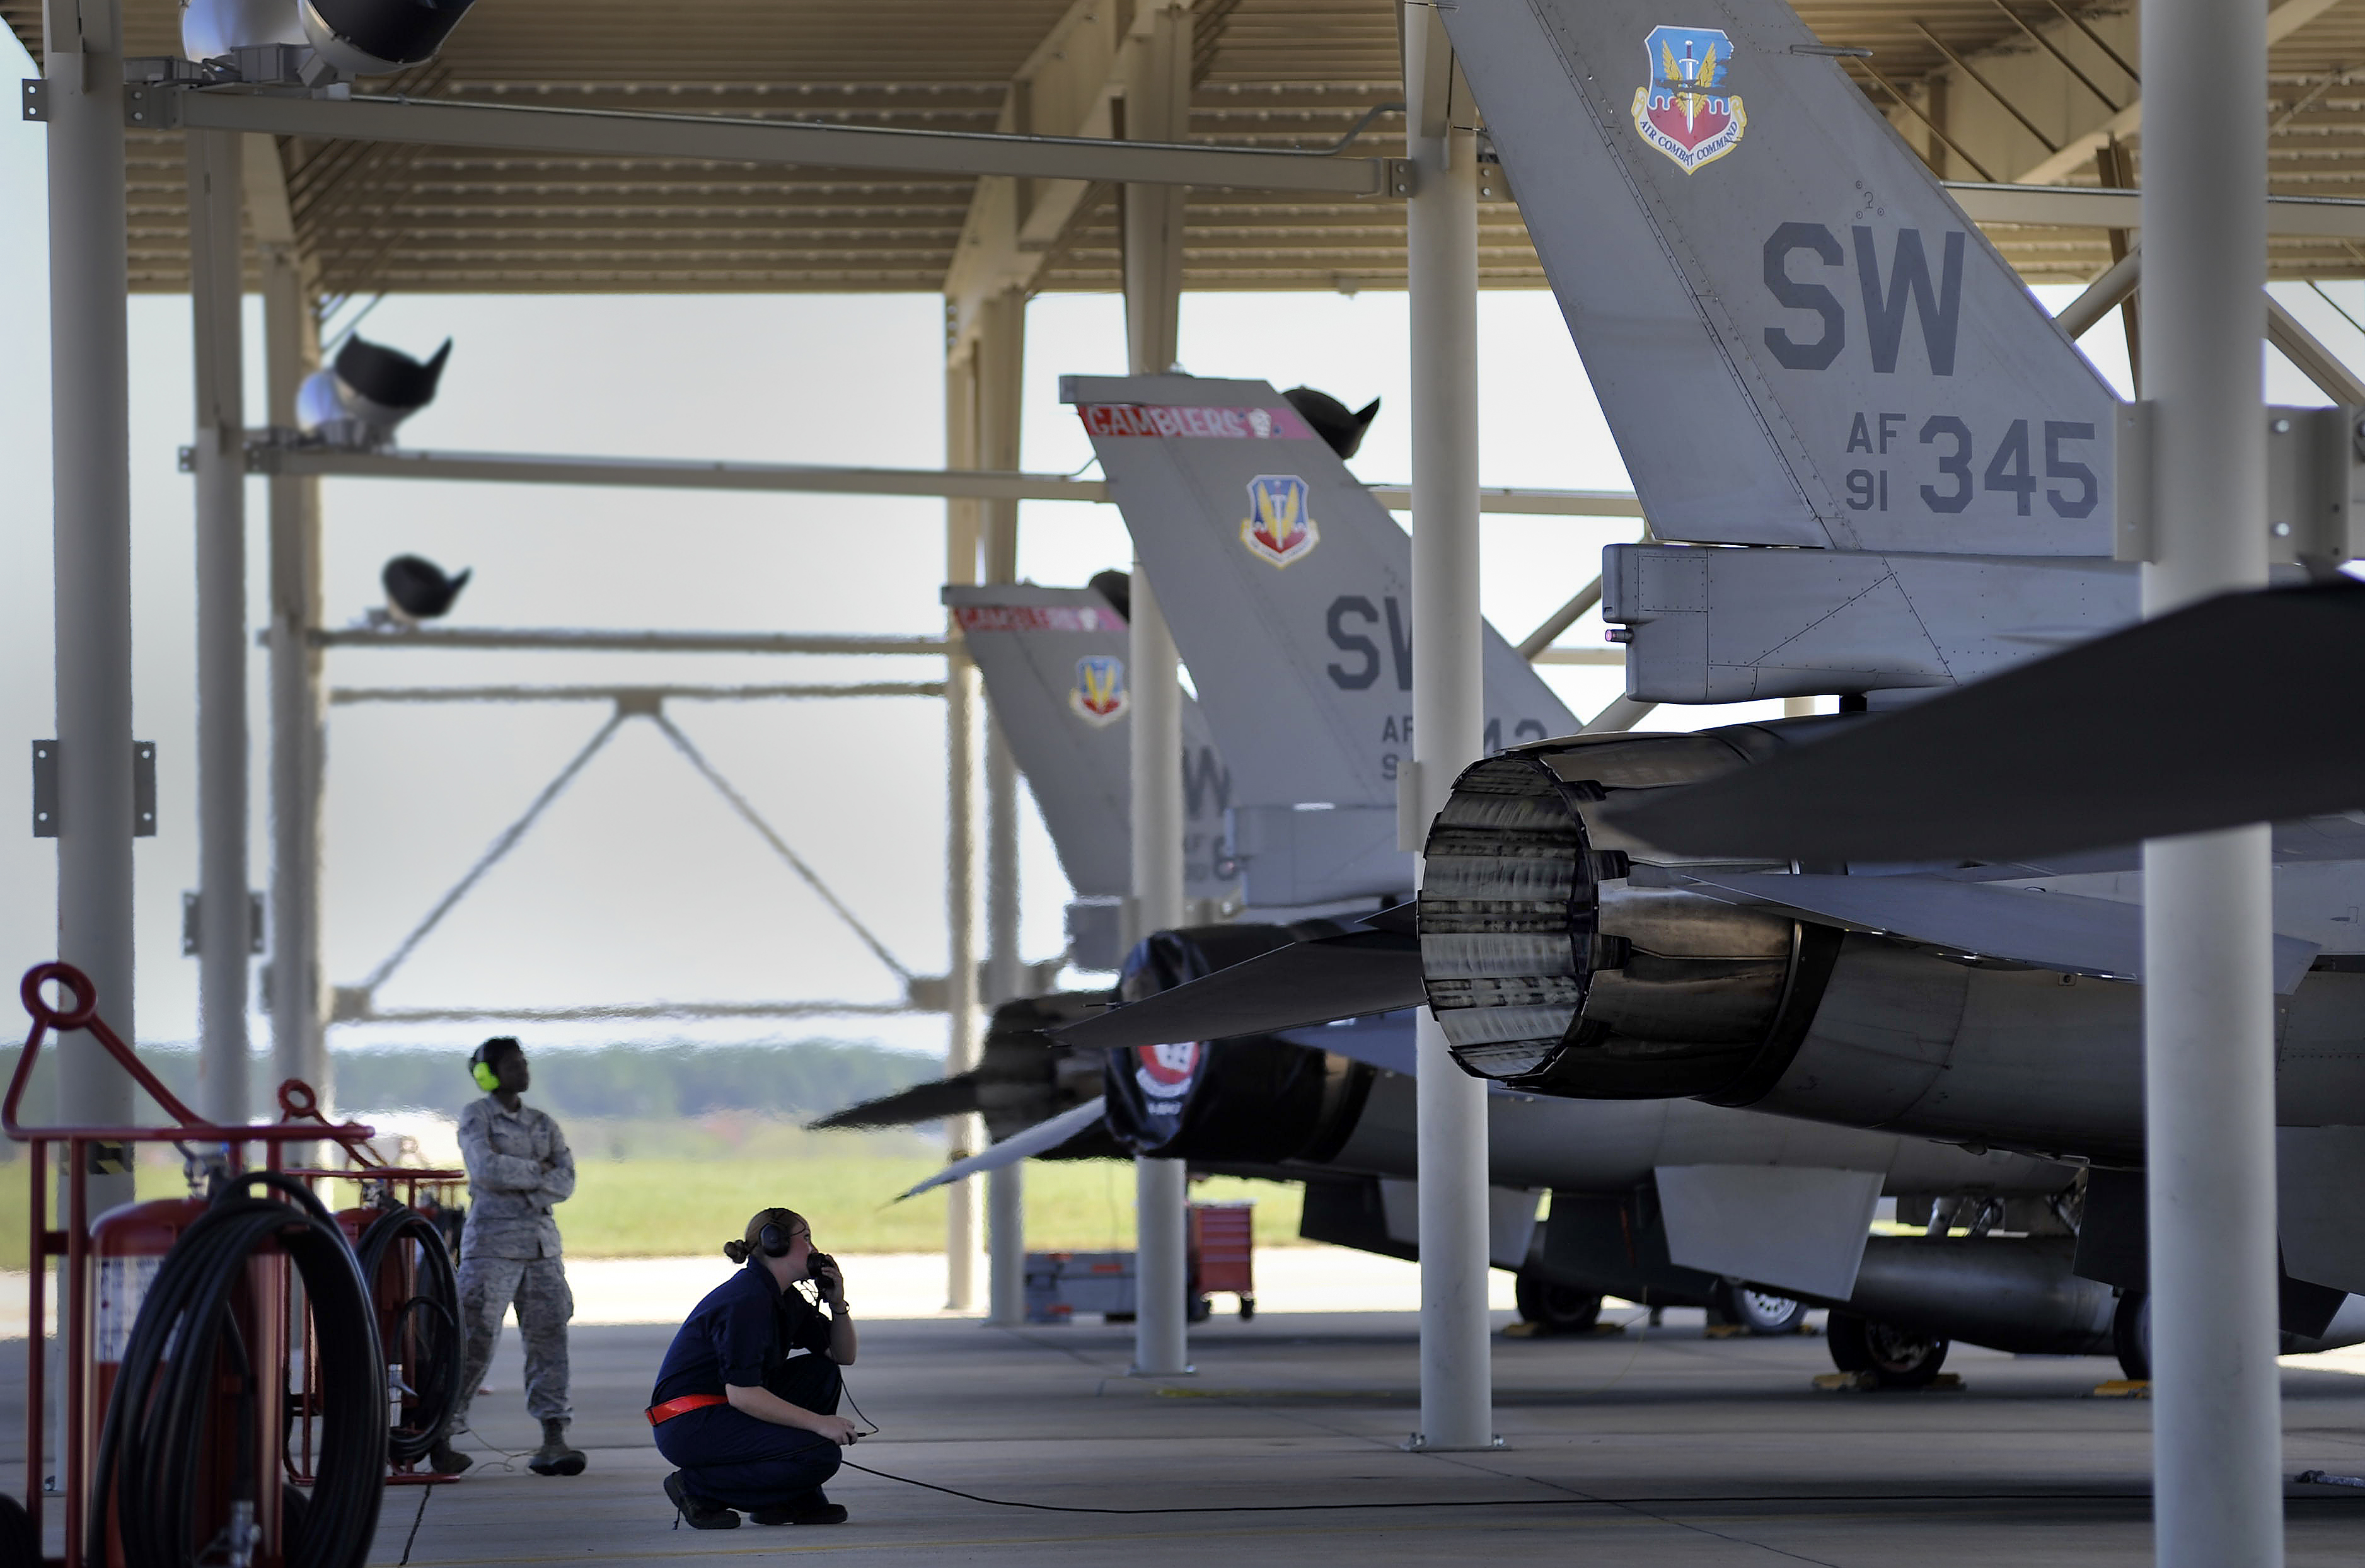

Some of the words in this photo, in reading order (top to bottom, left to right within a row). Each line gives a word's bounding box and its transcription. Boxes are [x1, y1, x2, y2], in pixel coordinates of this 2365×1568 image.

[1640, 120, 1657, 140] AIR
[1658, 136, 1694, 166] COMBAT
[1697, 121, 1738, 160] COMMAND
[1764, 221, 1965, 376] SW
[1846, 412, 1906, 454] AF
[1919, 415, 2098, 519] 345
[1846, 470, 1887, 511] 91
